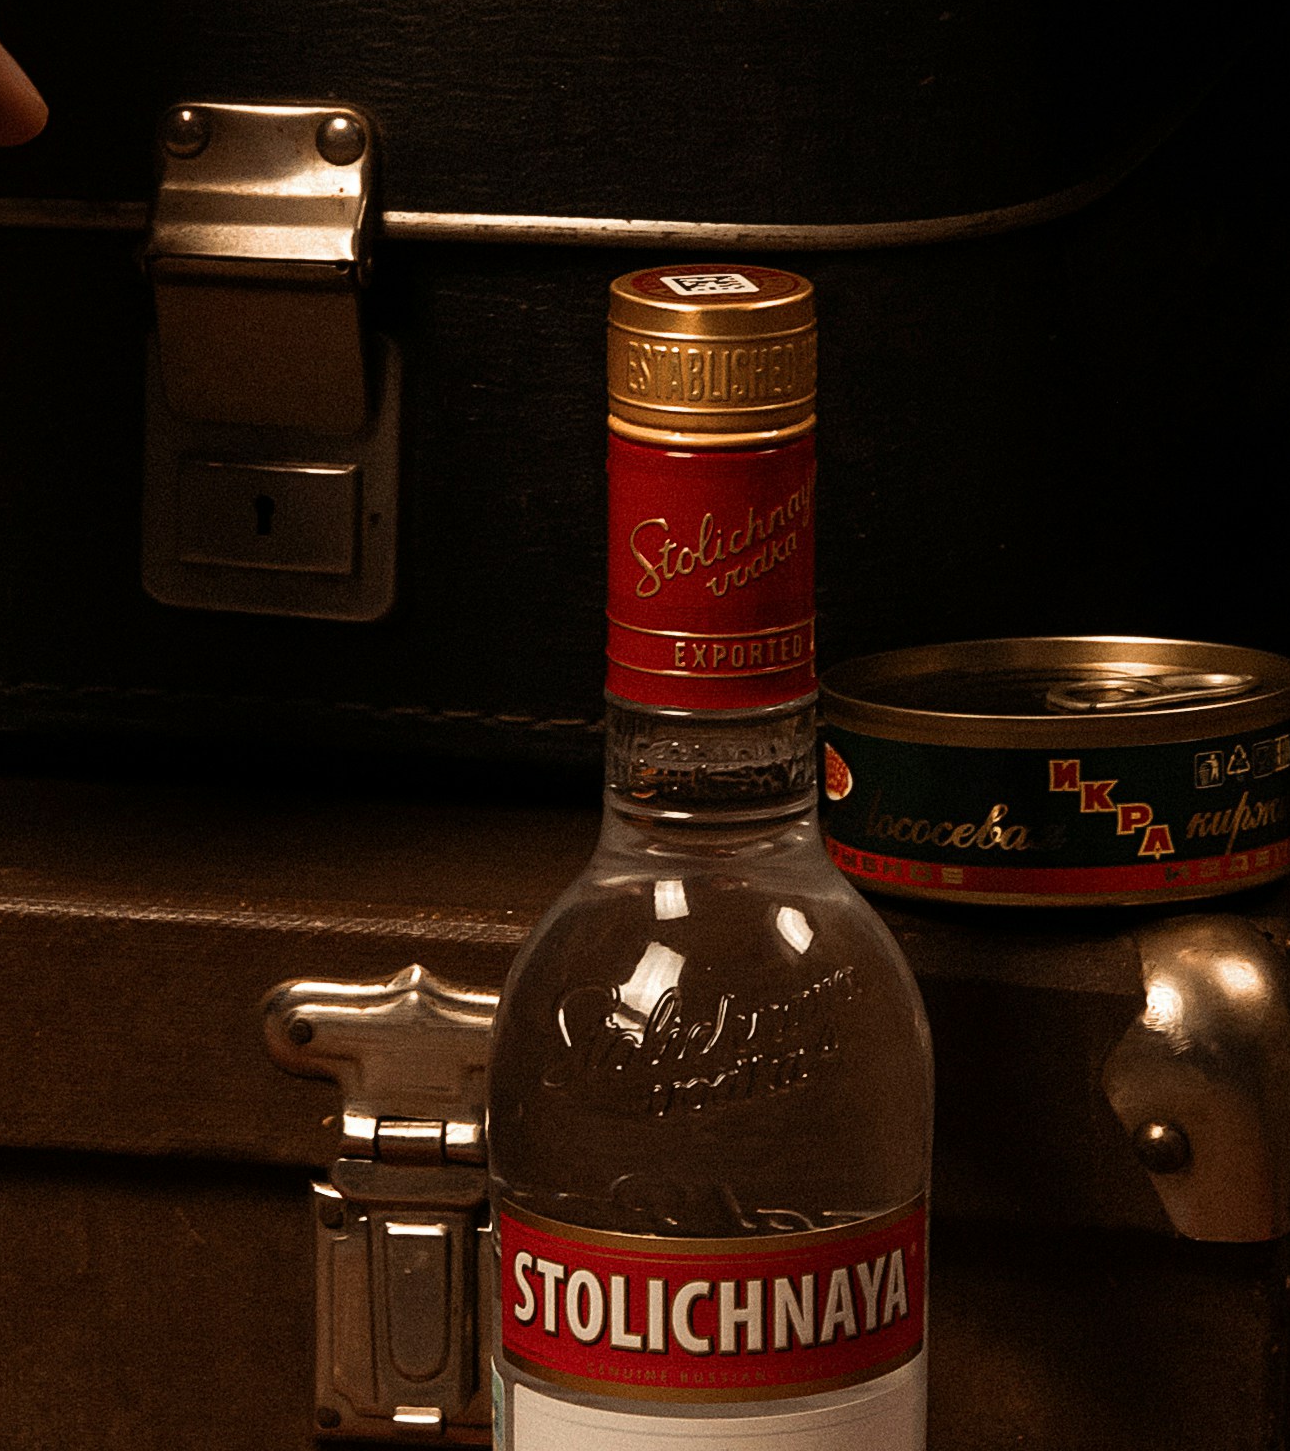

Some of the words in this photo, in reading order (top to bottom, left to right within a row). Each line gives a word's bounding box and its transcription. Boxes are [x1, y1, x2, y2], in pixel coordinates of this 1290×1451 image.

[628, 340, 795, 402] ESTABLISHED
[630, 477, 812, 598] Stolichnay
[706, 531, 798, 597] vodka
[674, 634, 803, 669] EXPORTED
[1048, 759, 1175, 860] ИКРА
[514, 1248, 909, 1356] STOLICHNAYA
